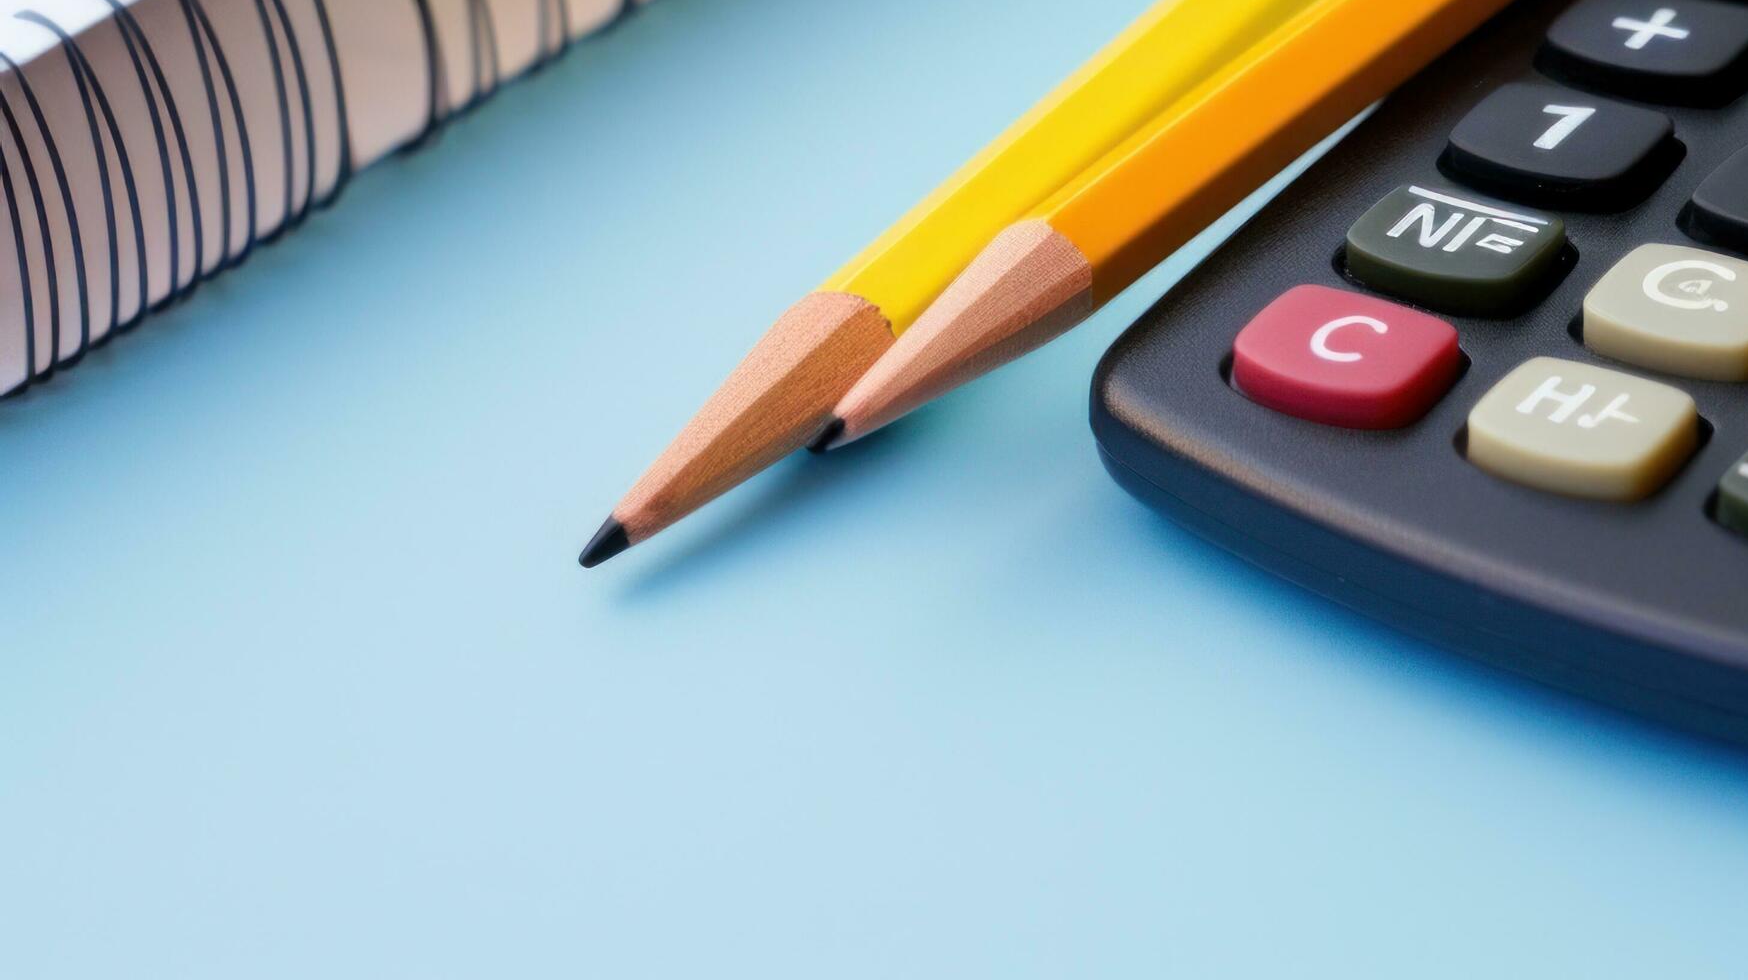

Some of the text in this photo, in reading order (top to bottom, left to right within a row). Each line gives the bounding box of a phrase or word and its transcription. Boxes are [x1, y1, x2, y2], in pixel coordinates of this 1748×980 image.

[1612, 8, 1690, 50] +
[1532, 104, 1597, 150] 1
[1309, 315, 1389, 363] C
